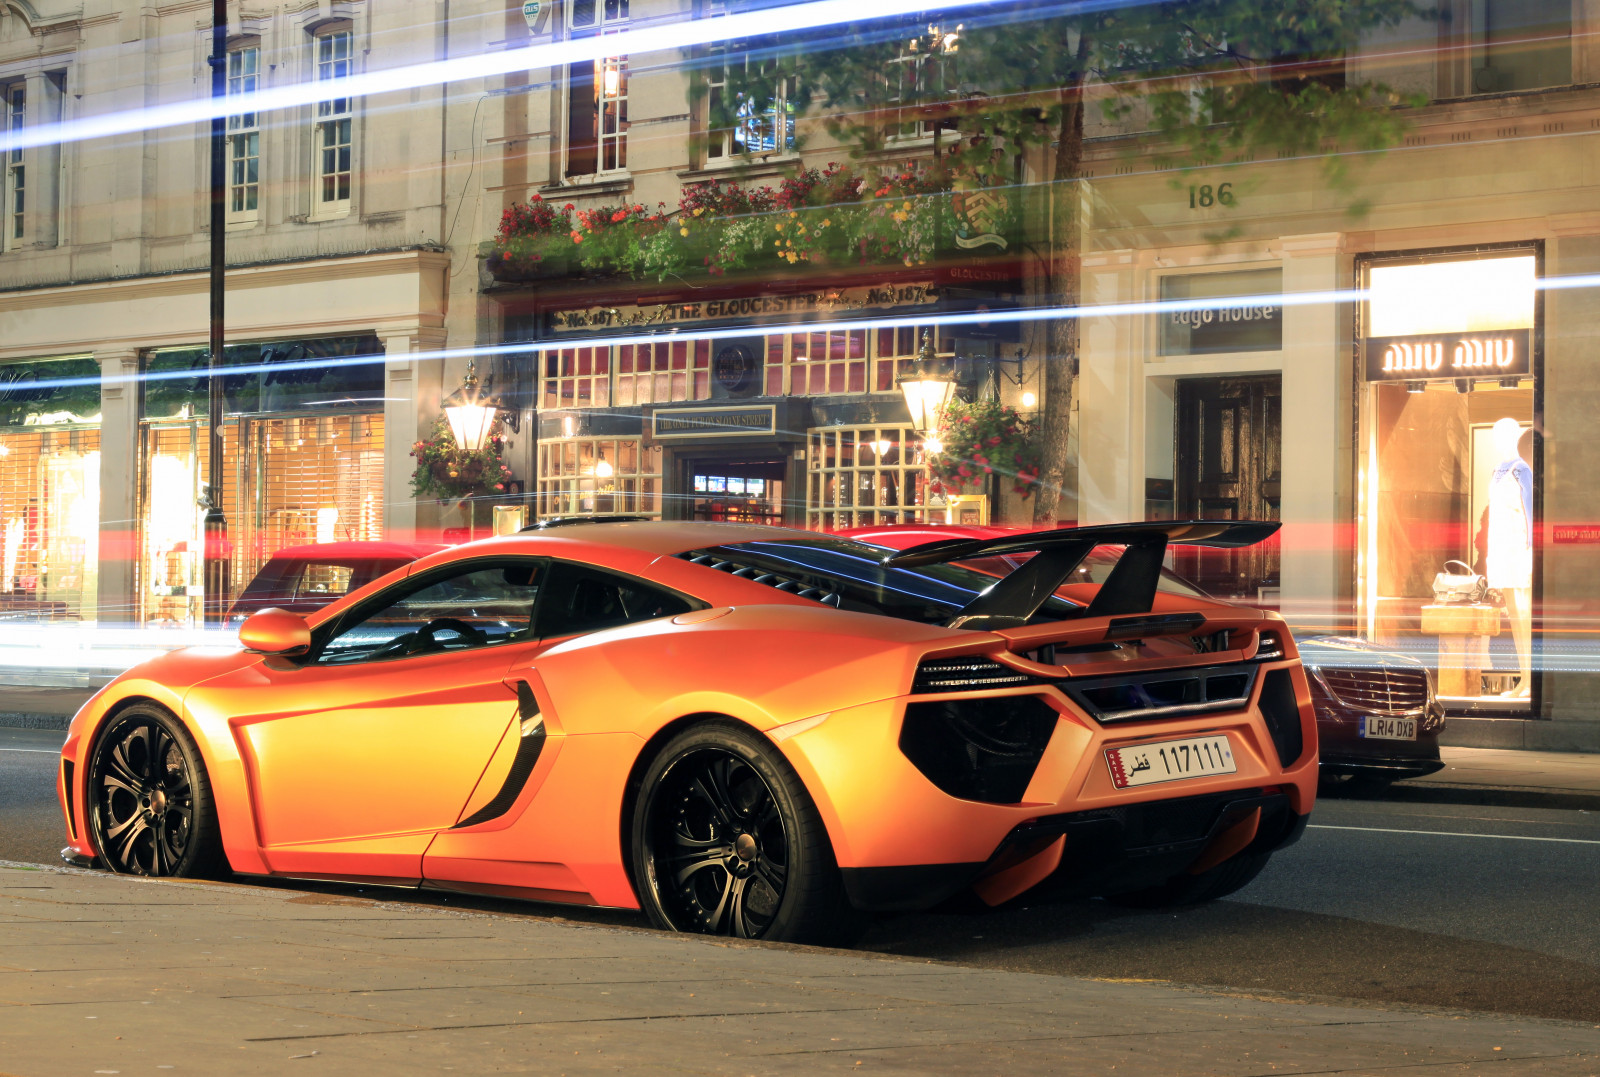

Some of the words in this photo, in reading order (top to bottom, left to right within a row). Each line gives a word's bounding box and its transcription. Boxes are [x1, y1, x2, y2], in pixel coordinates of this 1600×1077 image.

[1189, 182, 1233, 209] 186
[592, 309, 612, 327] 187
[668, 302, 701, 319] THE
[706, 293, 818, 318] GLOUCESTER
[897, 285, 924, 303] 187
[1219, 303, 1274, 322] House
[1382, 343, 1443, 371] miu
[1451, 338, 1514, 367] miu
[716, 414, 741, 427] SLOANE
[1369, 719, 1394, 737] LR14
[1396, 721, 1414, 738] DXB
[1109, 753, 1122, 786] QATAR
[1128, 753, 1151, 778] قطر
[1159, 741, 1225, 775] 117111
